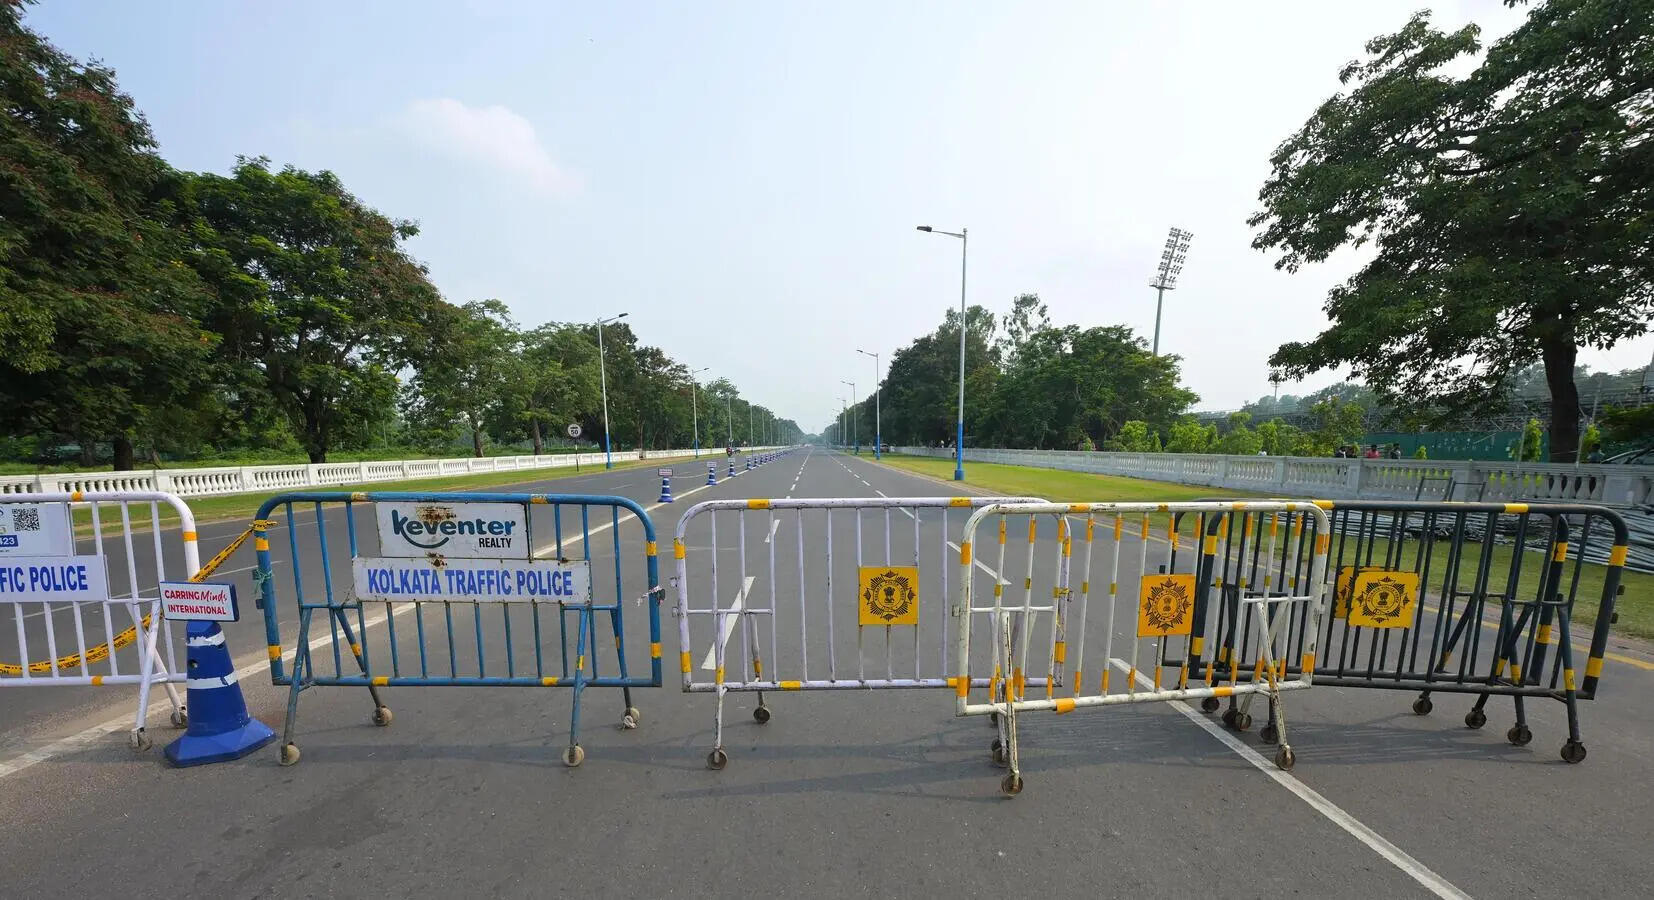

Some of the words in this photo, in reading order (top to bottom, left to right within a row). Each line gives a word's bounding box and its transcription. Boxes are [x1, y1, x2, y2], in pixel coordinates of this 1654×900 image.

[392, 509, 516, 548] keventer
[479, 537, 512, 549] REALTY
[29, 565, 88, 592] POLICE
[368, 568, 441, 594] KOLKATA
[445, 569, 512, 595] TRAFFIC
[516, 570, 573, 596] POLICE
[164, 589, 200, 600] CARRING
[200, 589, 227, 604] Minds
[167, 604, 227, 615] INTERNATIONAL
